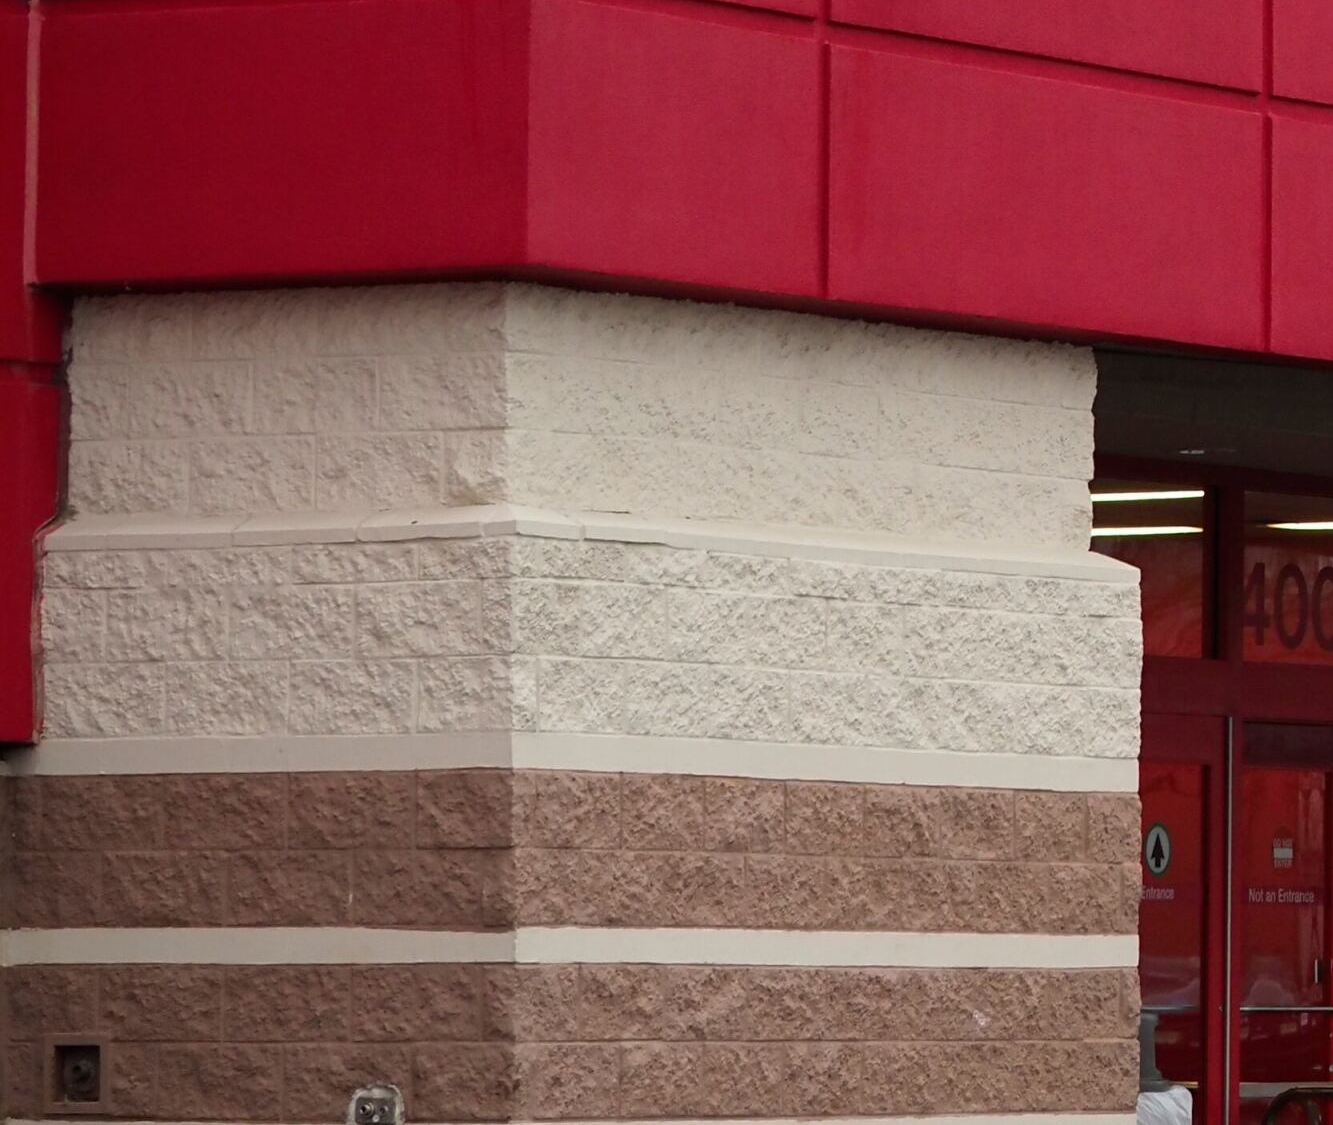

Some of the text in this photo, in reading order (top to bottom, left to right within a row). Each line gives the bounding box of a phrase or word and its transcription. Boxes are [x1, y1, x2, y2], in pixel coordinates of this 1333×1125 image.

[1249, 888, 1315, 904] Not an Entrance
